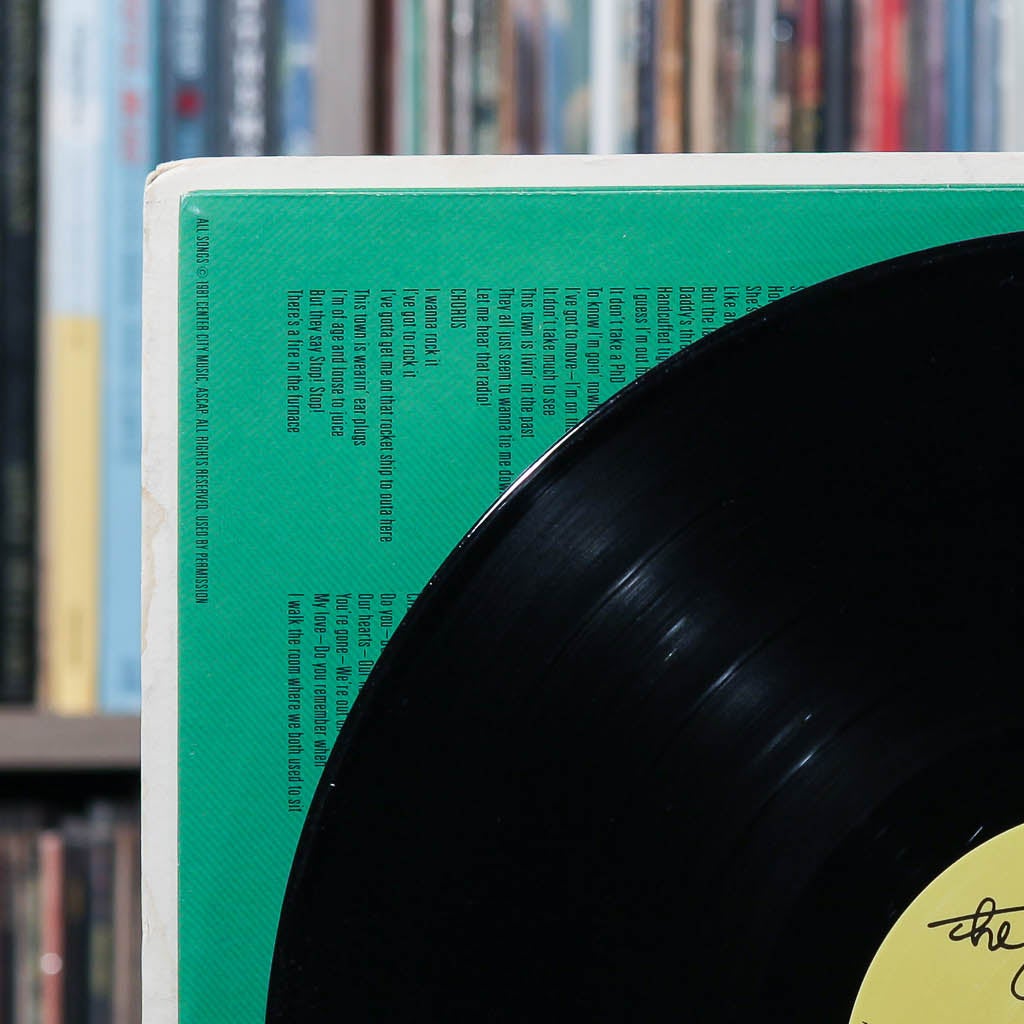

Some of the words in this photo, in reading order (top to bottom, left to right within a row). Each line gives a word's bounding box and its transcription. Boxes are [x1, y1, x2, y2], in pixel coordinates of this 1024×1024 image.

[196, 218, 209, 232] ALL
[196, 236, 209, 263] SONGS
[196, 282, 209, 298] 1981
[309, 289, 325, 306] But
[380, 289, 394, 307] I've
[196, 302, 208, 330] CENTER
[451, 288, 466, 329] CHORUS
[308, 310, 325, 331] they
[378, 312, 394, 337] gotta
[196, 334, 208, 351] CITY
[308, 336, 321, 351] say
[378, 342, 394, 357] get
[195, 355, 208, 384] MUSIC,
[308, 356, 325, 382] Stop!
[380, 361, 391, 375] me
[380, 380, 391, 392] on
[308, 387, 325, 412] Stop!
[380, 396, 394, 415] that
[196, 419, 208, 432] ALL
[380, 419, 394, 450] rocket
[196, 437, 208, 466] RIGHTS
[378, 454, 394, 475] ship
[196, 469, 208, 512] RESERVED.
[380, 480, 393, 489] to
[380, 493, 393, 515] outa
[196, 516, 208, 536] USED
[380, 519, 394, 542] here
[196, 540, 208, 549] BY
[195, 553, 208, 603] PERMISSION
[288, 601, 304, 625] walk
[288, 629, 303, 644] the
[288, 650, 300, 674] room
[288, 678, 303, 710] where
[288, 714, 300, 728] we
[288, 732, 303, 754] both
[288, 759, 303, 782] used
[288, 786, 302, 795] to
[288, 800, 303, 812] sit
